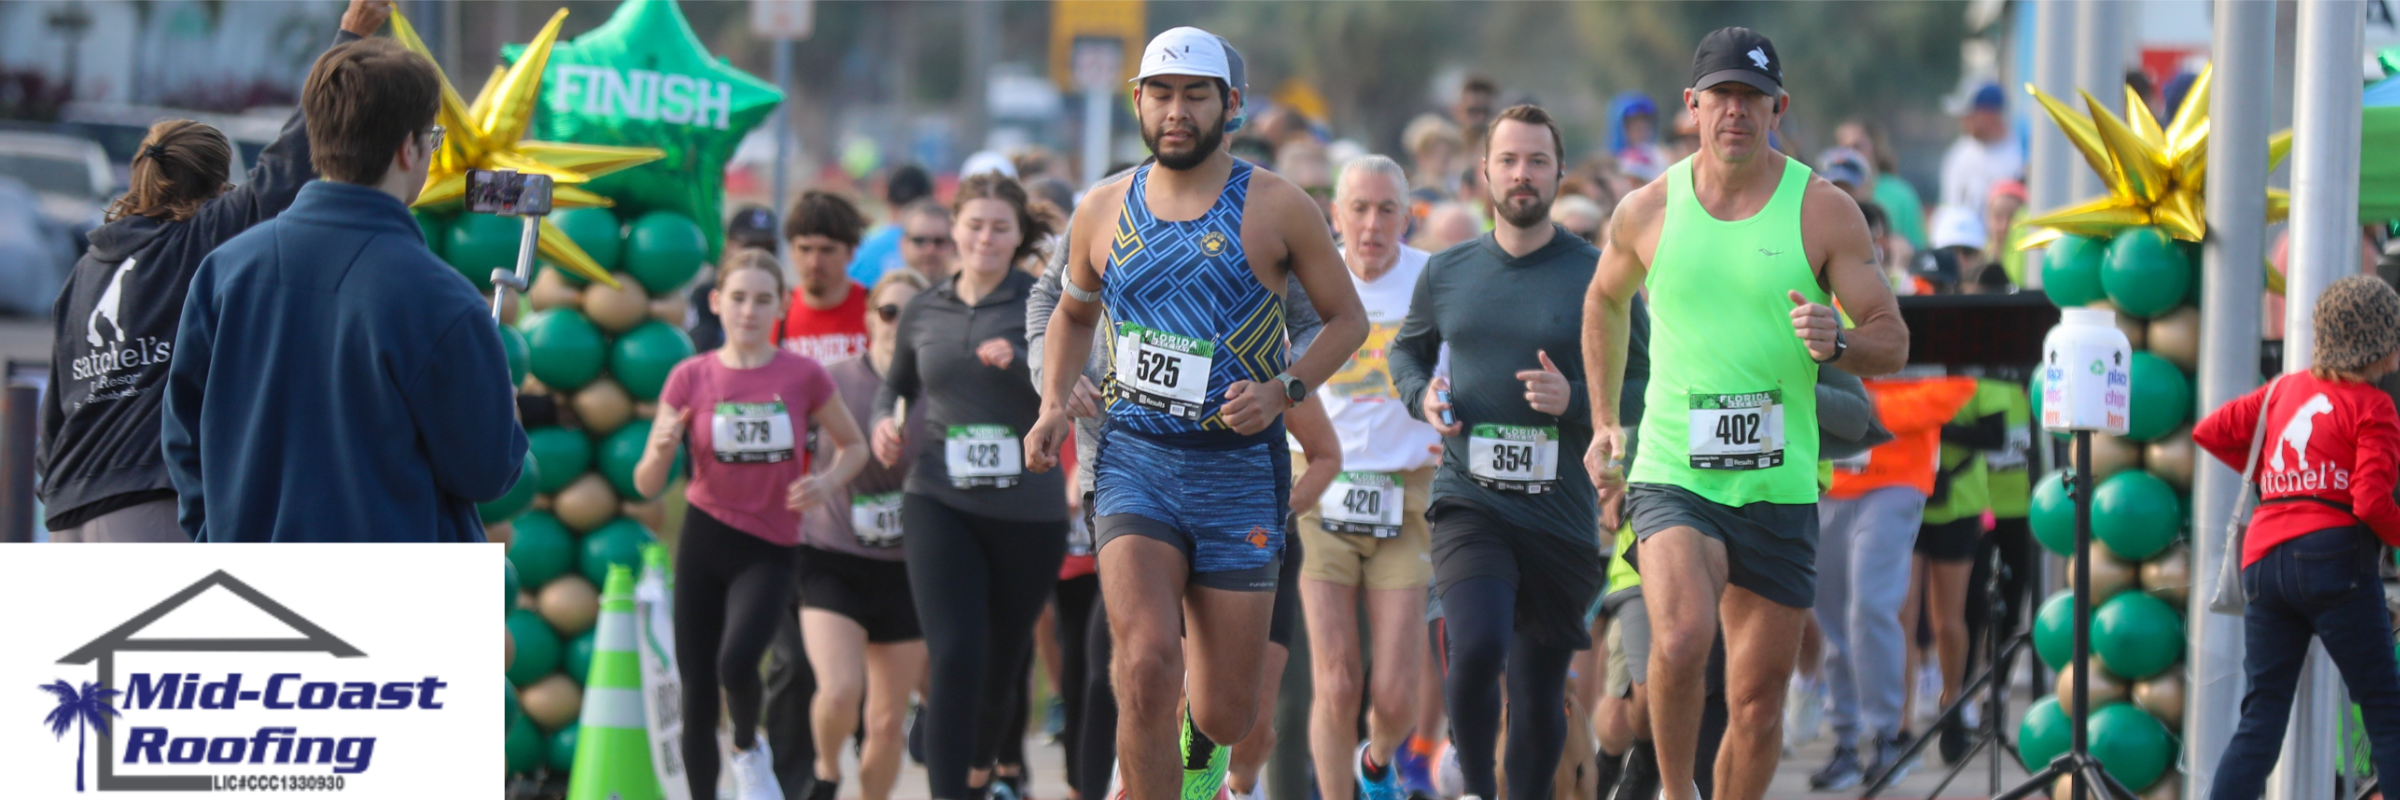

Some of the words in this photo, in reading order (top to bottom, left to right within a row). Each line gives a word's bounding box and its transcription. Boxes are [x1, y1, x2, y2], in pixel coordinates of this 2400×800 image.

[555, 64, 732, 131] FINISH
[1145, 329, 1197, 350] FLORIDA
[1137, 350, 1181, 388] 525
[1146, 397, 1166, 409] Results
[1719, 393, 1770, 403] FLORIDA
[736, 421, 771, 443] 379
[1498, 427, 1546, 437] FLORIDA
[1715, 413, 1761, 445] 402
[966, 444, 999, 468] 423
[1493, 444, 1533, 472] 354
[1350, 472, 1392, 482] FLORIDA
[1506, 482, 1525, 490] Results
[1343, 489, 1381, 516] 420
